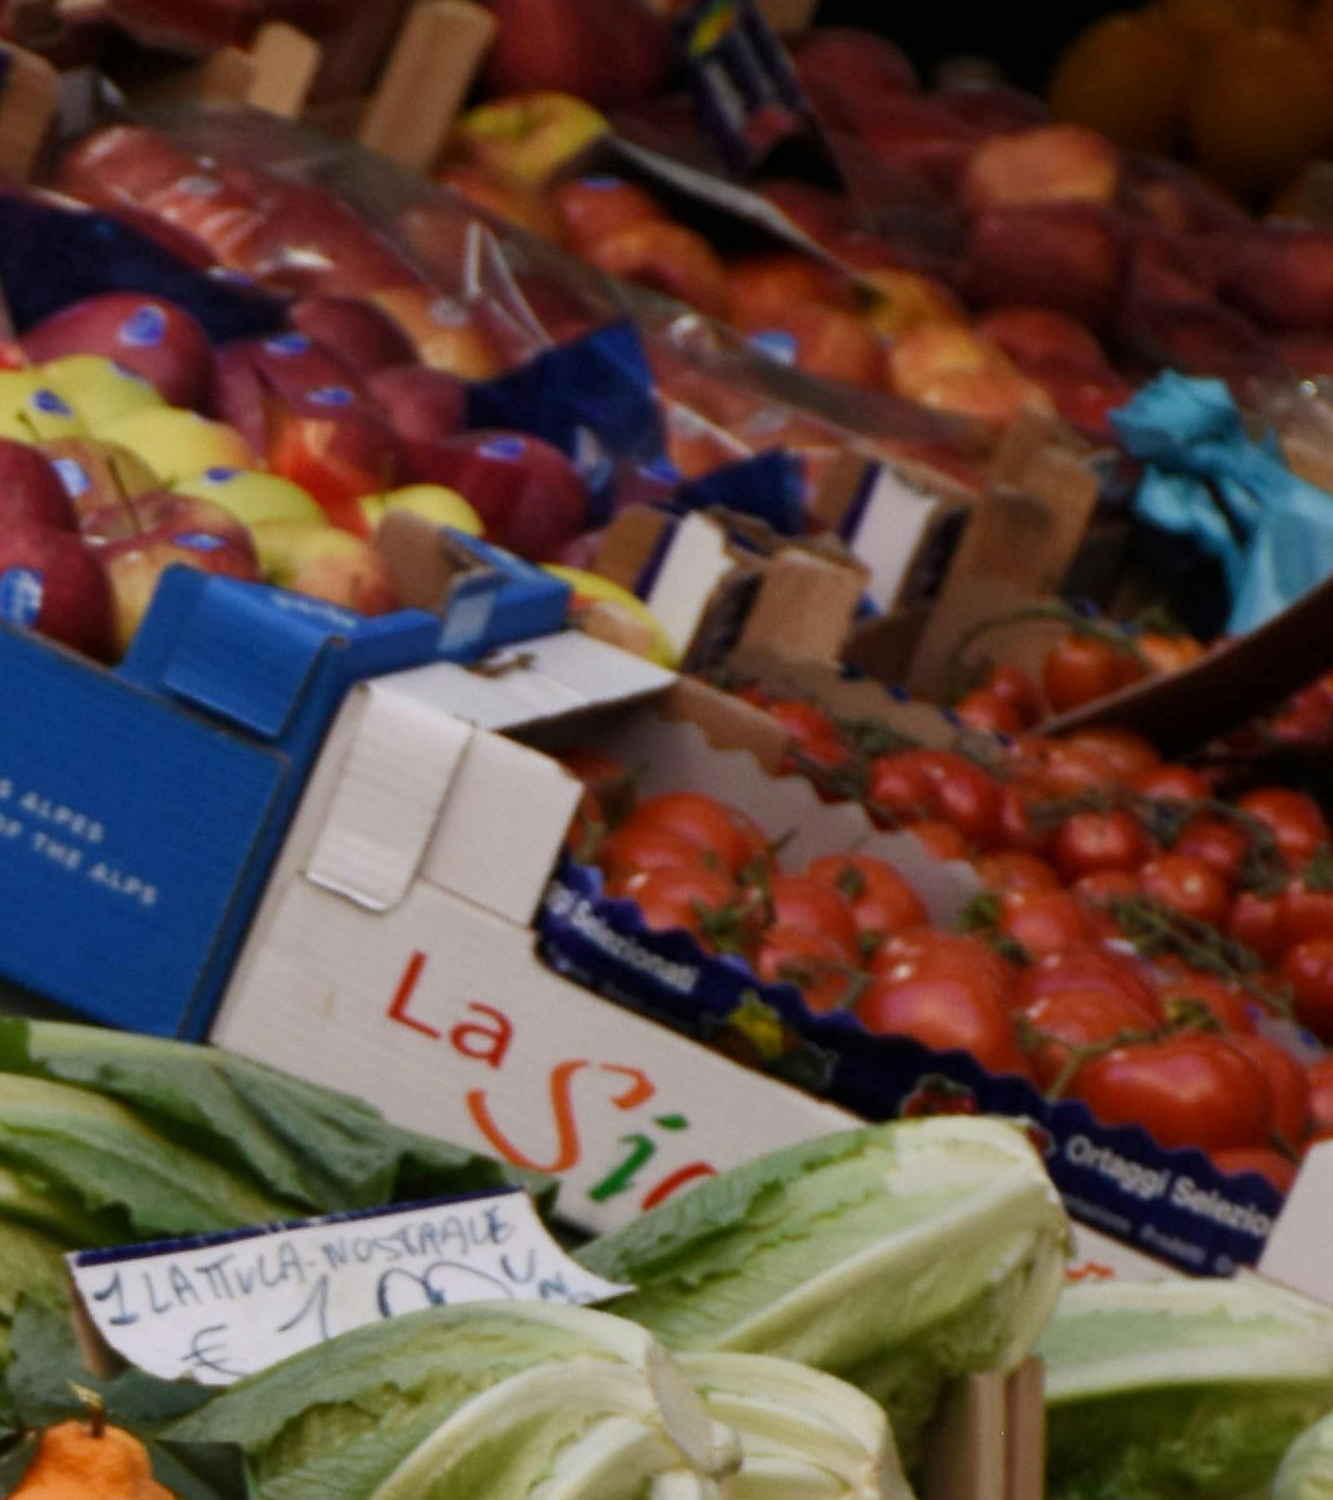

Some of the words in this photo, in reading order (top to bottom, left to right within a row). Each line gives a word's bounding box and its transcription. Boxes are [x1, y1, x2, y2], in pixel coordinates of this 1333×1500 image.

[19, 790, 105, 845] ALPES
[33, 830, 83, 871] THE
[88, 861, 159, 906] ALPS
[386, 951, 514, 1069] La
[1064, 1133, 1162, 1201] Ortaggi
